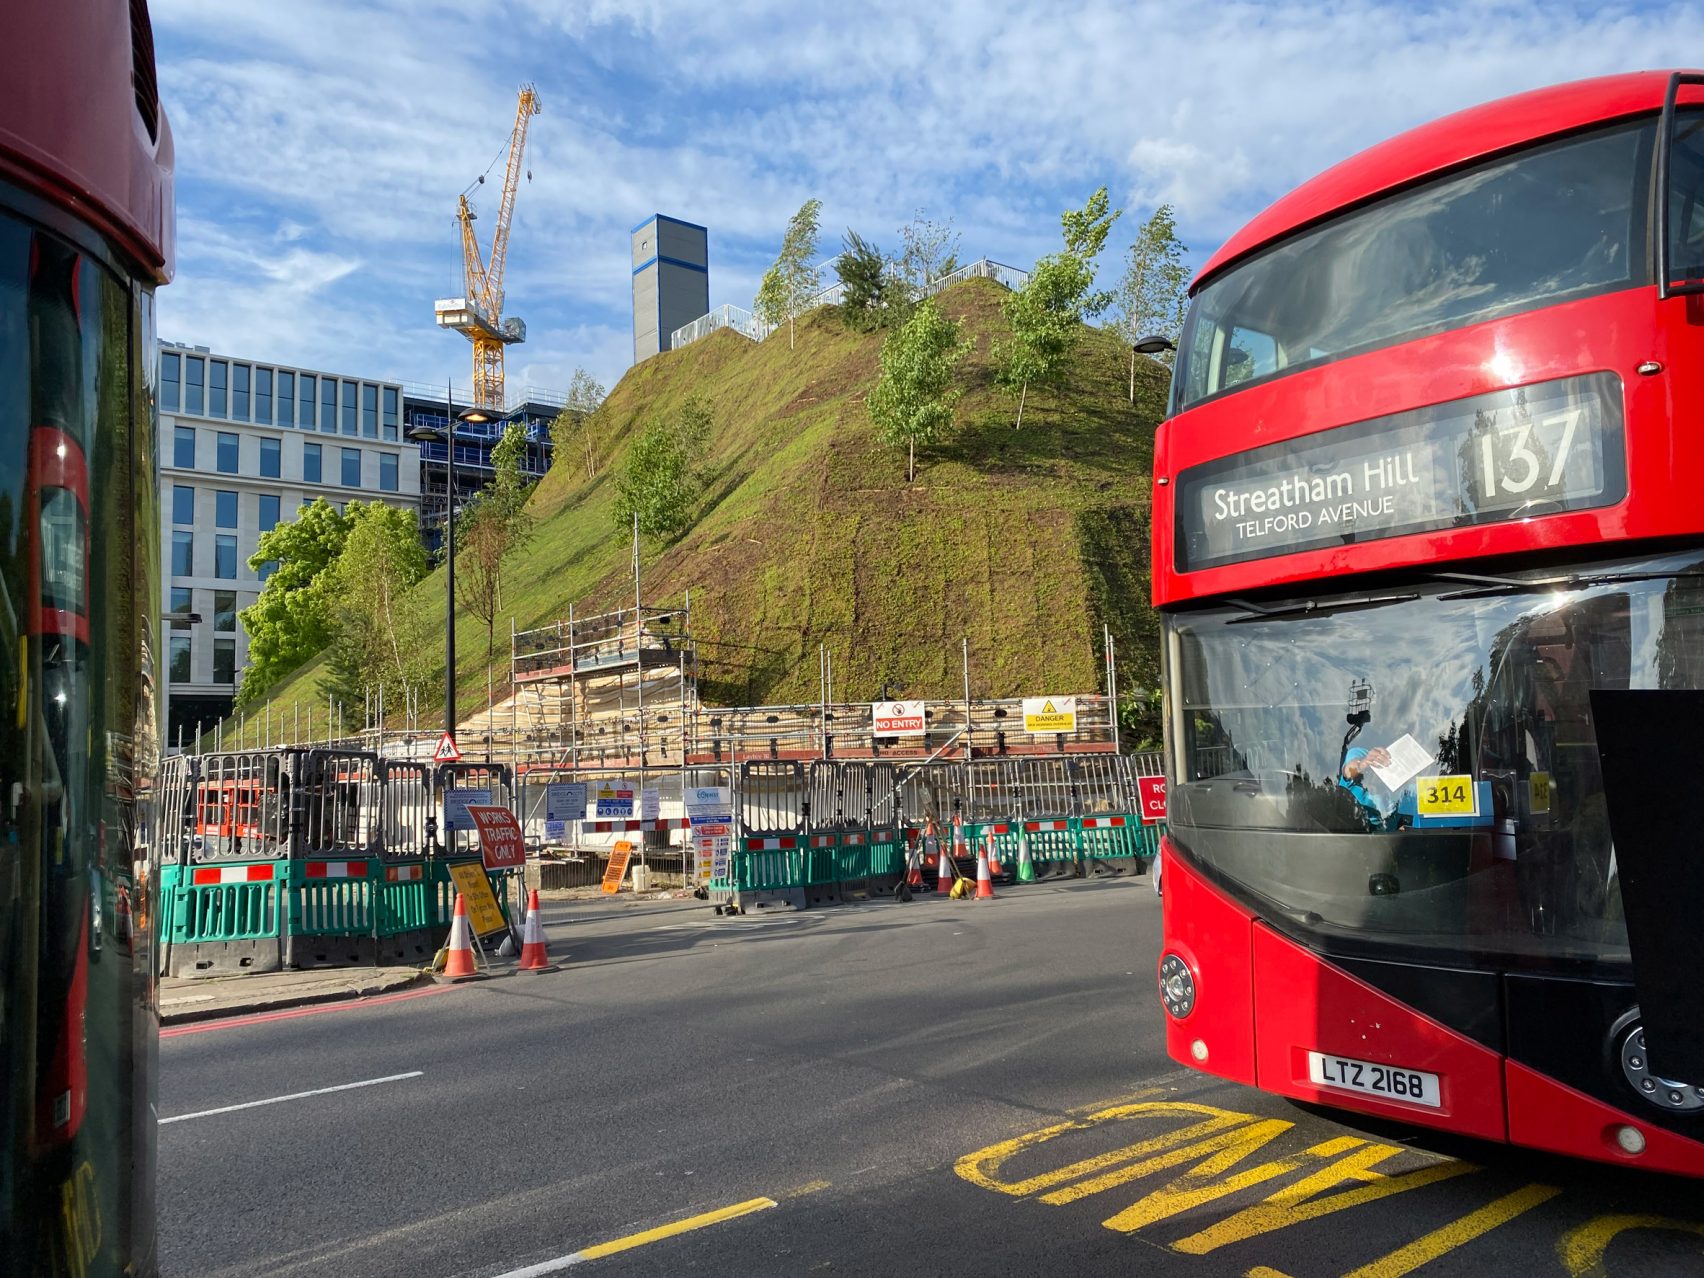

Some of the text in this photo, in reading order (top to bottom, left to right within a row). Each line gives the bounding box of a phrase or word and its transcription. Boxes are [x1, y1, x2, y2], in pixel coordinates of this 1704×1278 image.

[1482, 410, 1582, 498] 137
[1214, 452, 1419, 521] Streatham Hill
[1235, 495, 1395, 540] TELFORD AVENUE
[876, 719, 922, 729] NO ENTRY
[1035, 714, 1064, 722] DANGER
[1426, 785, 1466, 804] 314
[477, 811, 511, 825] WORKS
[484, 827, 518, 842] TRAFFIC
[494, 844, 516, 860] ONLY
[1322, 1057, 1424, 1099] LTZ 2168
